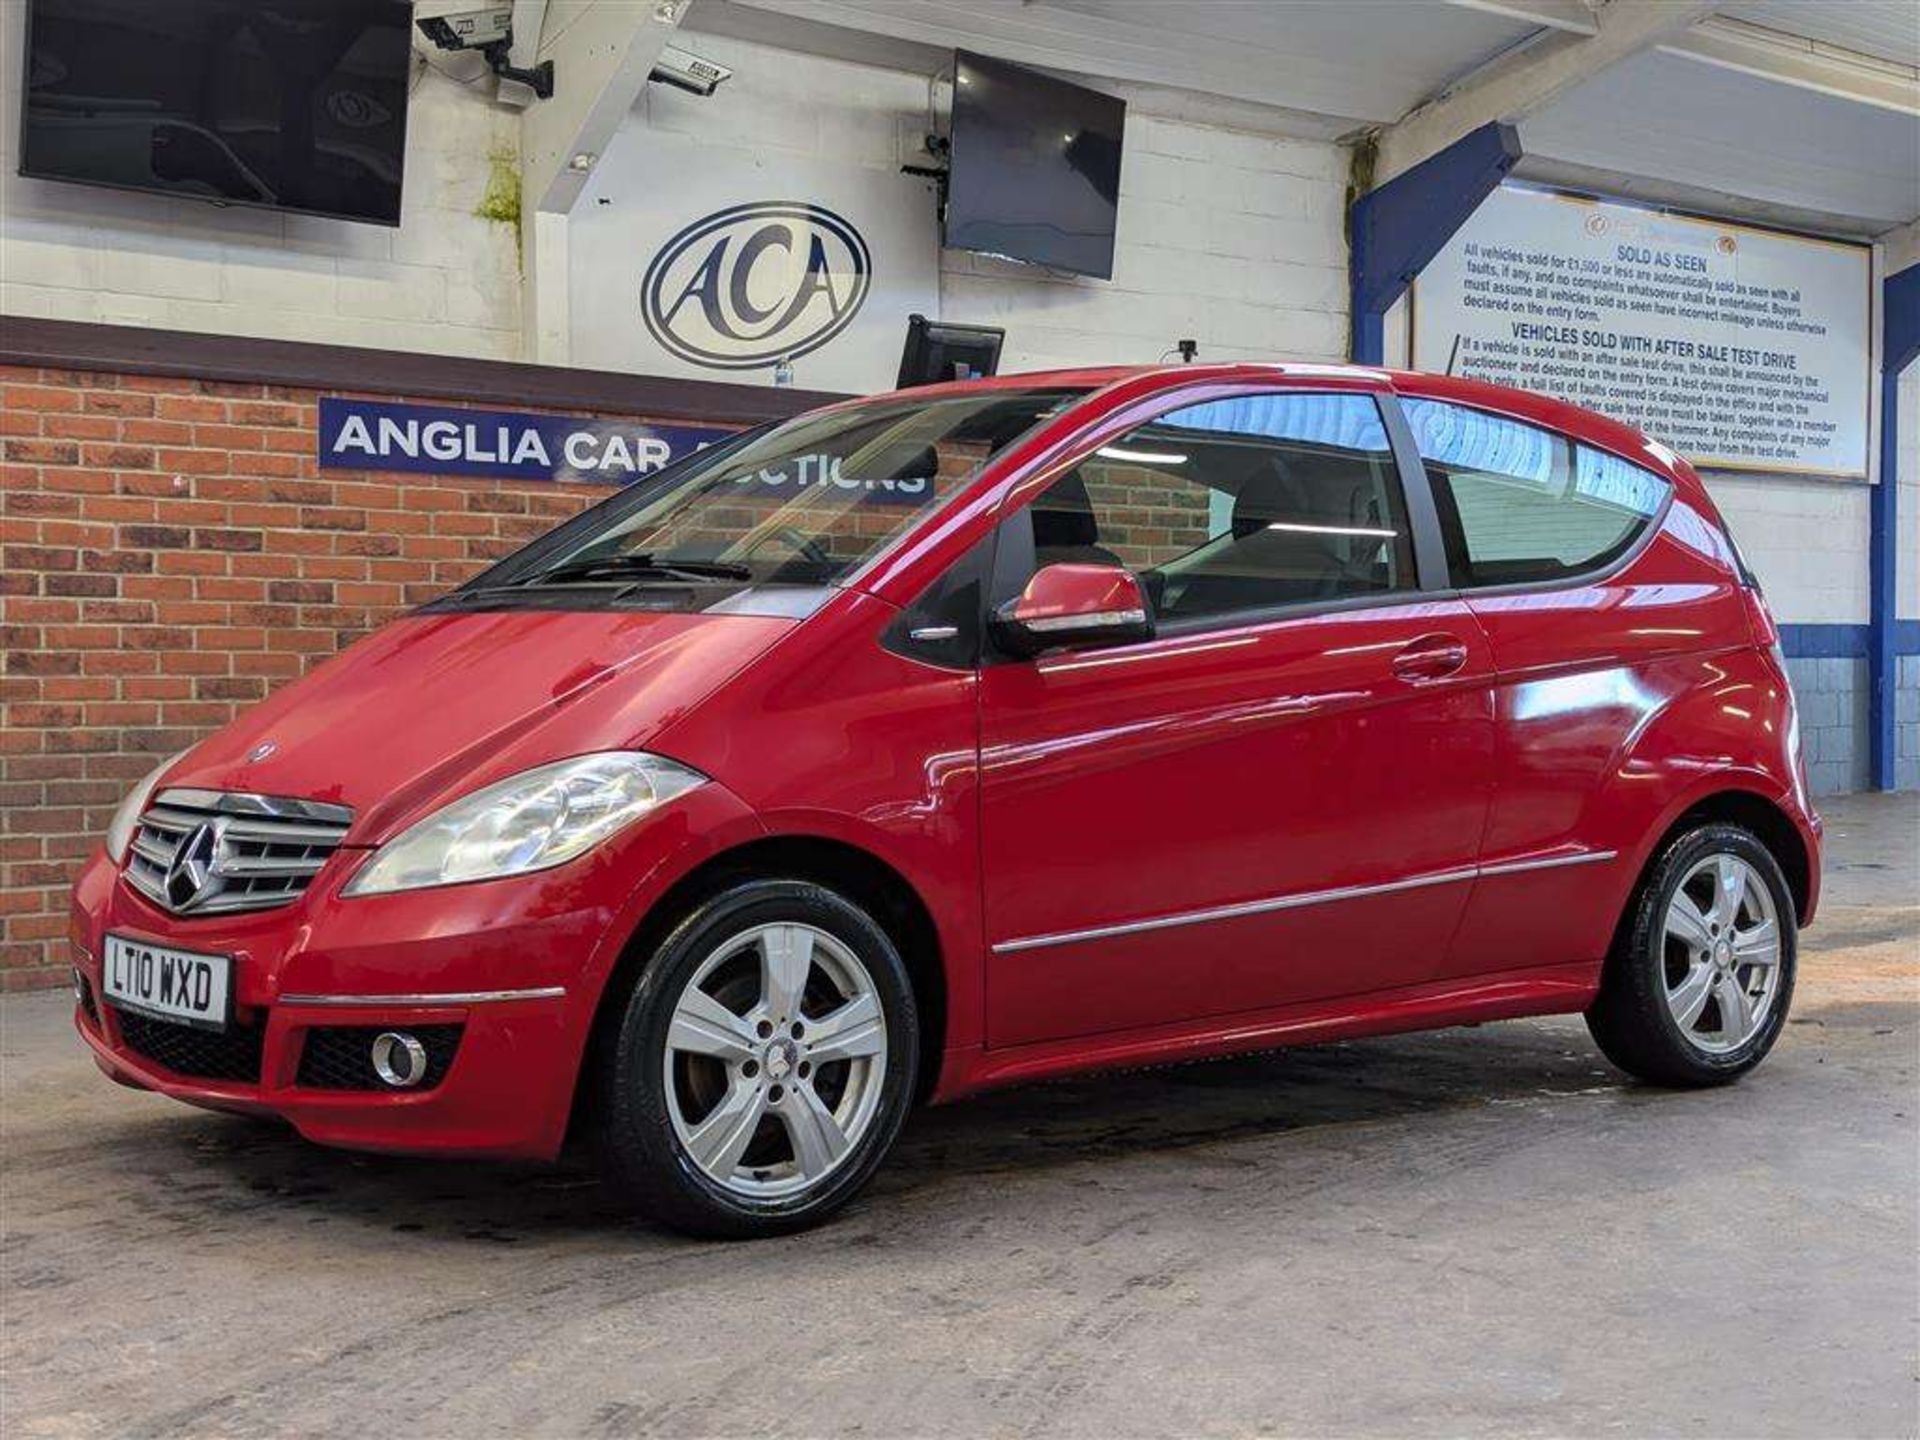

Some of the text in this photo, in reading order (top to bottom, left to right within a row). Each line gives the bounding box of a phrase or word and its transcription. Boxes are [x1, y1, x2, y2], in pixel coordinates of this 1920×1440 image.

[1464, 243, 1478, 256] All
[1481, 246, 1524, 262] vehicles
[1526, 254, 1548, 266] sold
[1551, 256, 1565, 268] for
[1568, 258, 1600, 274] £1,500
[1602, 264, 1612, 274] or
[1614, 265, 1633, 278] less
[1637, 269, 1650, 281] are
[1654, 271, 1713, 292] automatically
[1715, 281, 1734, 293] sold
[1736, 284, 1747, 294] as
[1749, 286, 1768, 297] seen
[1617, 245, 1707, 272] SOLD AS SEEN
[663, 224, 839, 341] ACA
[1502, 265, 1509, 277] if
[1535, 272, 1554, 283] and
[1557, 276, 1569, 285] no
[1572, 276, 1624, 293] complaints
[1627, 283, 1679, 299] whatsoever
[1682, 291, 1702, 303] shall
[1706, 294, 1716, 305] be
[1464, 279, 1826, 335] must assume all vehicles sold as seen have incorrect mileage unless otherwise
[1464, 295, 1600, 321] declared on the entry form.
[1463, 337, 1470, 349] If
[1473, 341, 1479, 350] a
[1483, 340, 1518, 355] vehicle
[1522, 343, 1531, 356] is
[1534, 346, 1555, 358] sold
[1558, 349, 1579, 361] with
[1582, 352, 1594, 362] an
[1596, 352, 1617, 365] after
[1620, 356, 1639, 368] sale
[1641, 357, 1660, 371] test
[1689, 362, 1706, 375] this
[1709, 364, 1730, 377] shall
[1732, 368, 1743, 379] be
[1745, 370, 1791, 385] announced
[1793, 375, 1803, 386] by
[1805, 376, 1819, 387] the
[1512, 322, 1796, 370] VEHICLES SOLD WITH AFTER SALE TEST DRIVE
[1462, 356, 1517, 371] auctioneer
[1520, 361, 1539, 373] and
[1542, 364, 1585, 378] declared
[1588, 367, 1600, 378] on
[1602, 368, 1617, 381] the
[1620, 372, 1643, 386] entry
[1672, 376, 1679, 387] A
[1681, 378, 1699, 390] test
[1701, 380, 1723, 393] drive
[1725, 382, 1754, 395] covers
[1757, 386, 1781, 400] major
[1783, 389, 1829, 403] mechanical
[1521, 378, 1528, 389] a
[1530, 377, 1547, 391] full
[1549, 378, 1565, 392] list
[1568, 381, 1577, 393] of
[1579, 383, 1607, 397] faults
[1608, 387, 1650, 400] covered
[1652, 390, 1659, 401] is
[1659, 391, 1703, 406] displayed
[1705, 394, 1714, 406] in
[1715, 396, 1730, 408] the
[1732, 398, 1756, 411] office
[1759, 400, 1774, 412] and
[1604, 401, 1623, 413] sale
[1626, 404, 1644, 417] test
[1646, 405, 1669, 418] drive
[1671, 408, 1694, 420] must
[1696, 410, 1707, 421] be
[1740, 413, 1775, 428] together
[1777, 416, 1795, 429] with
[1803, 421, 1837, 433] member
[1642, 421, 1652, 432] of
[1653, 423, 1669, 434] the
[1712, 427, 1730, 441] Any
[1731, 428, 1777, 444] complaints
[1806, 435, 1831, 449] major
[333, 415, 551, 467] ANGLIA
[563, 432, 671, 473] CAR
[1677, 440, 1694, 452] one
[1696, 440, 1717, 453] hour
[1719, 443, 1739, 454] from
[114, 942, 212, 1012] LT10 WXD
